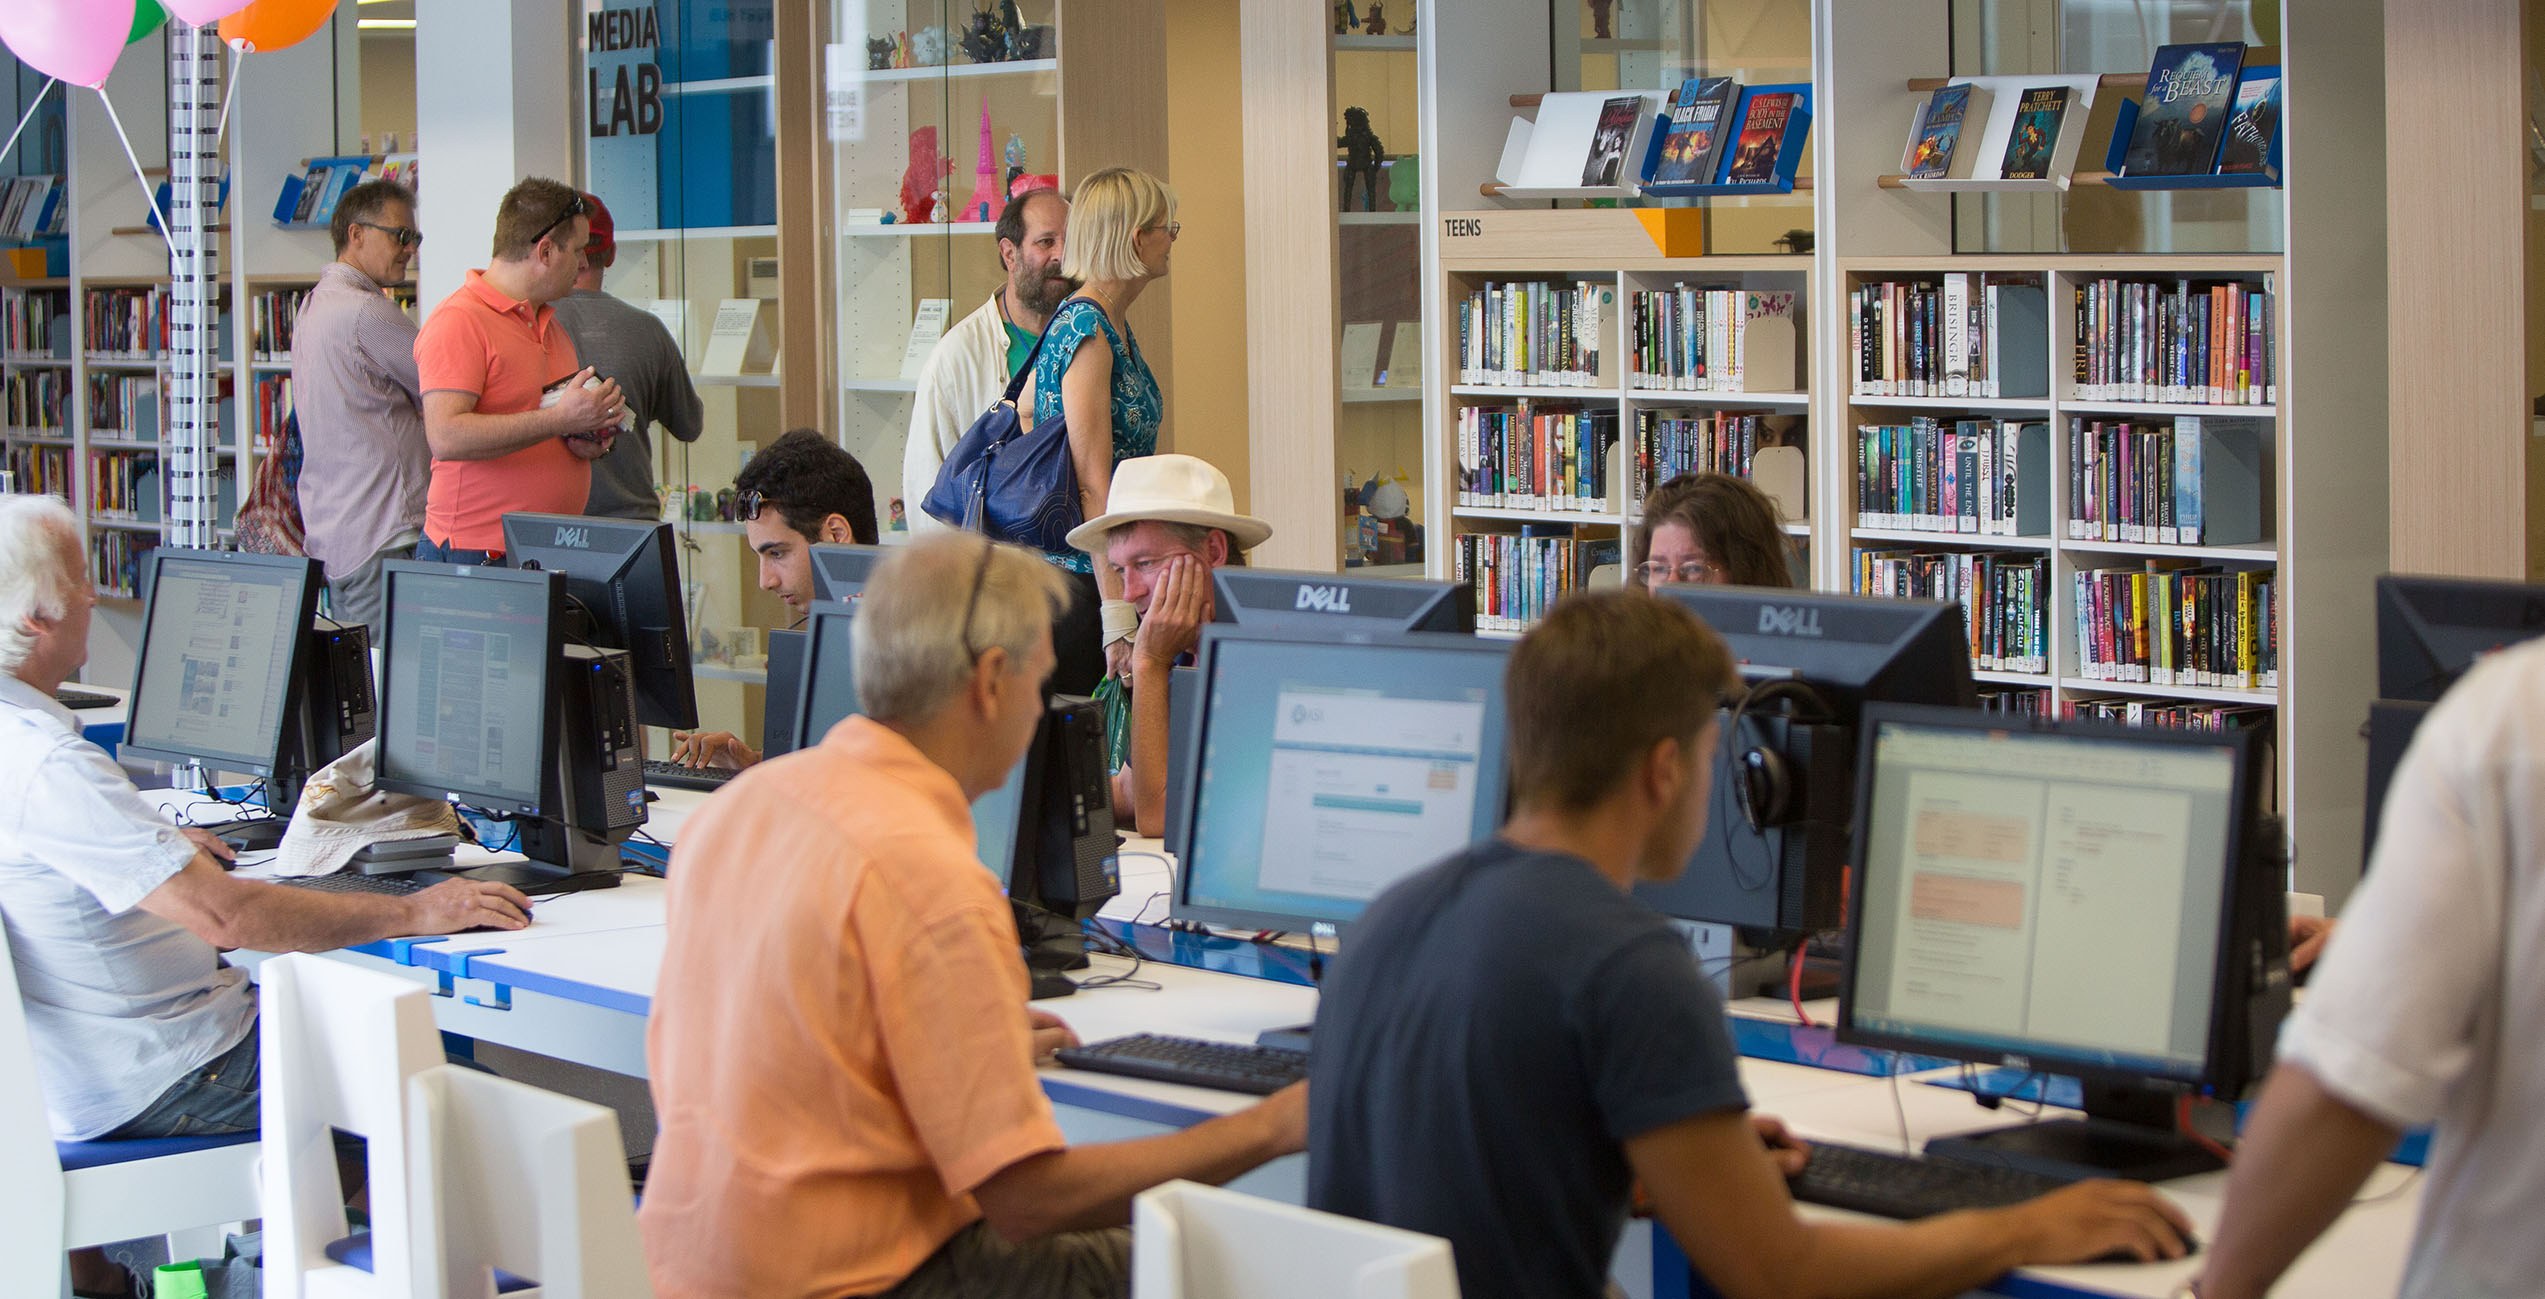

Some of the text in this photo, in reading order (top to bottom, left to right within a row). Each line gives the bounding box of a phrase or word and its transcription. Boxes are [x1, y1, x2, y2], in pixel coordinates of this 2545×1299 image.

[588, 6, 661, 52] MEDIA
[2160, 68, 2208, 83] REQUIEM
[589, 63, 664, 137] LAB
[2033, 90, 2056, 102] TERRY
[2150, 83, 2162, 95] for
[2163, 79, 2226, 103] BEAST
[1672, 105, 1720, 123] BLACK FRIDAY
[2019, 100, 2064, 113] PRATCHETT
[1746, 118, 1785, 130] BASEMENT
[2009, 171, 2035, 179] DODGER
[1445, 219, 1482, 237] TEENS
[1949, 294, 1958, 364] BRISINGR
[2075, 344, 2087, 380] FIRE
[554, 526, 590, 549] DELL
[1898, 568, 1906, 597] Stre
[1296, 584, 1351, 612] DELL
[2017, 569, 2025, 648] NOWHERE
[1758, 604, 1823, 635] DELL
